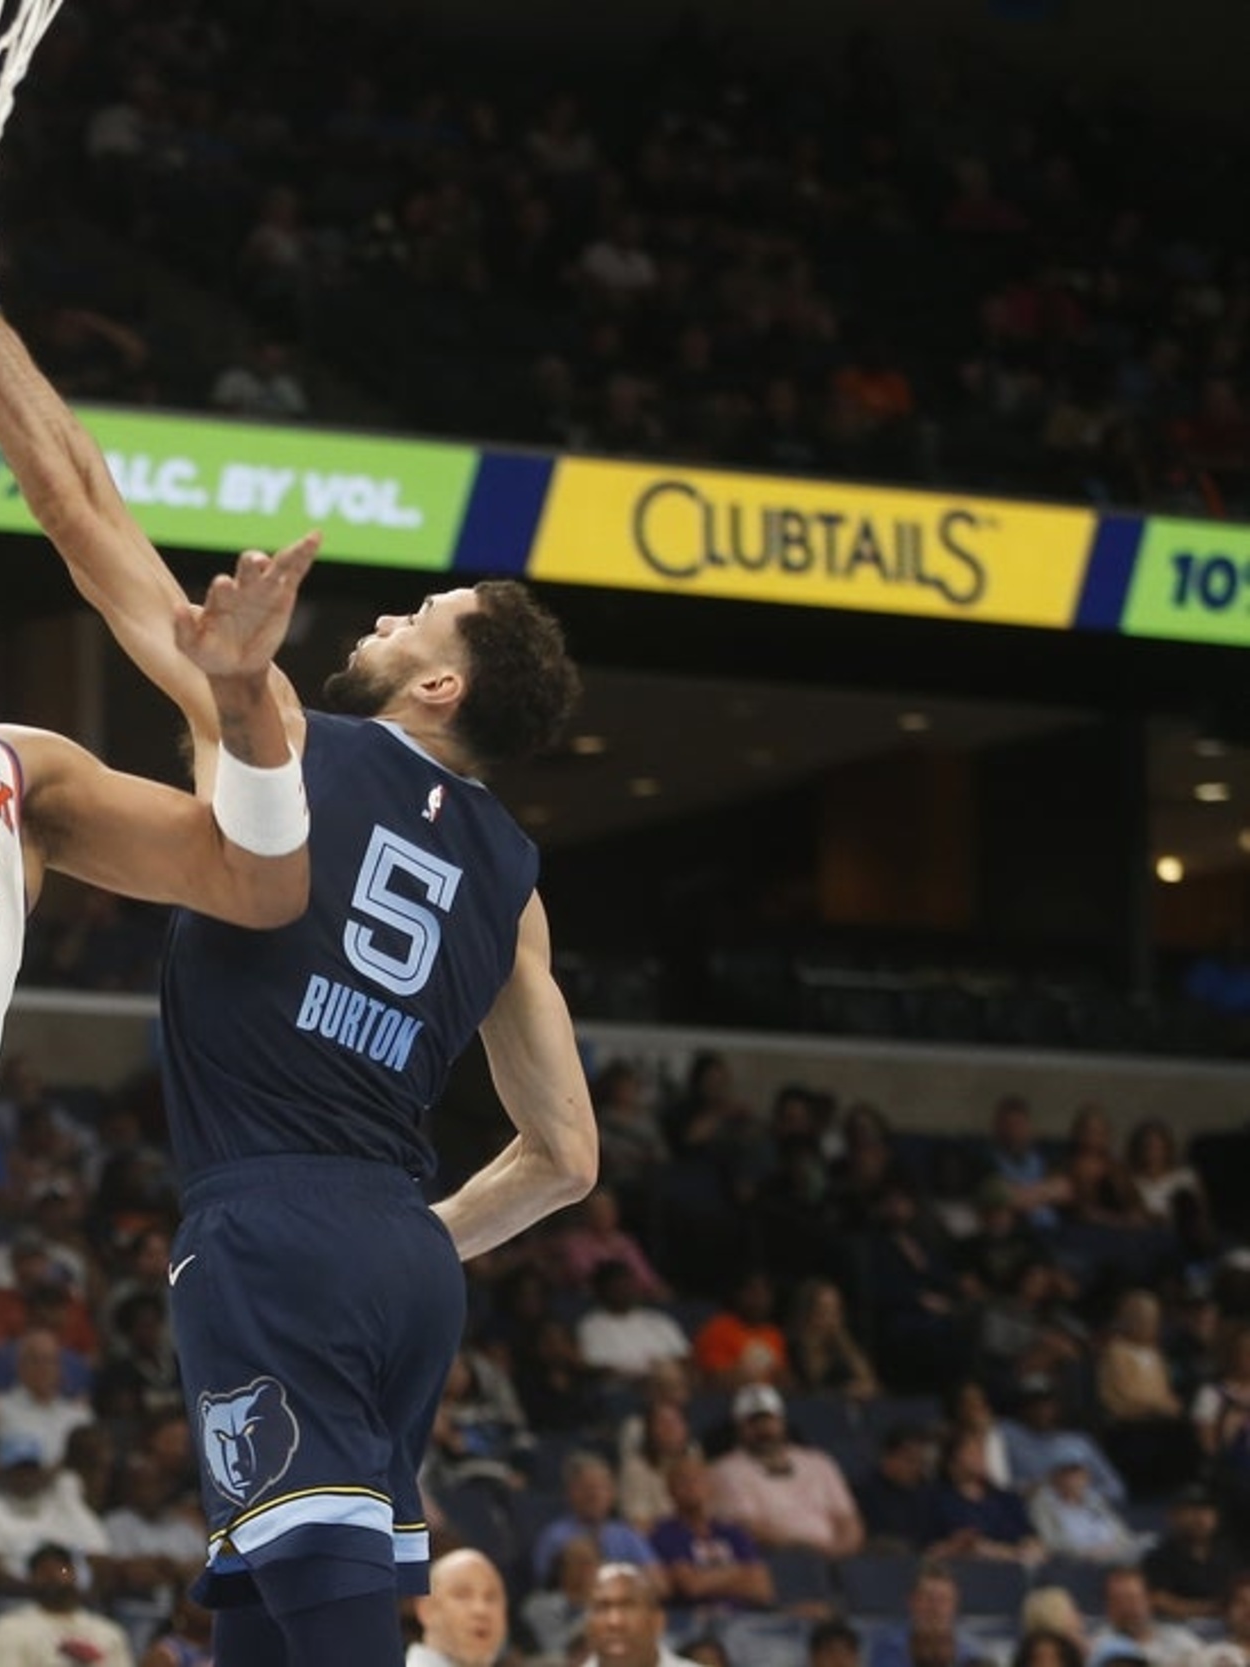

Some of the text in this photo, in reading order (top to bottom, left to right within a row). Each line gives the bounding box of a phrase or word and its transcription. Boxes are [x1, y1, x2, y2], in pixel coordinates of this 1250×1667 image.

[215, 461, 296, 517] BY
[302, 470, 425, 530] VOL.
[633, 480, 986, 606] CLUBTAILS
[1169, 550, 1250, 615] 10
[343, 823, 464, 997] 5
[296, 973, 424, 1073] BURTON
